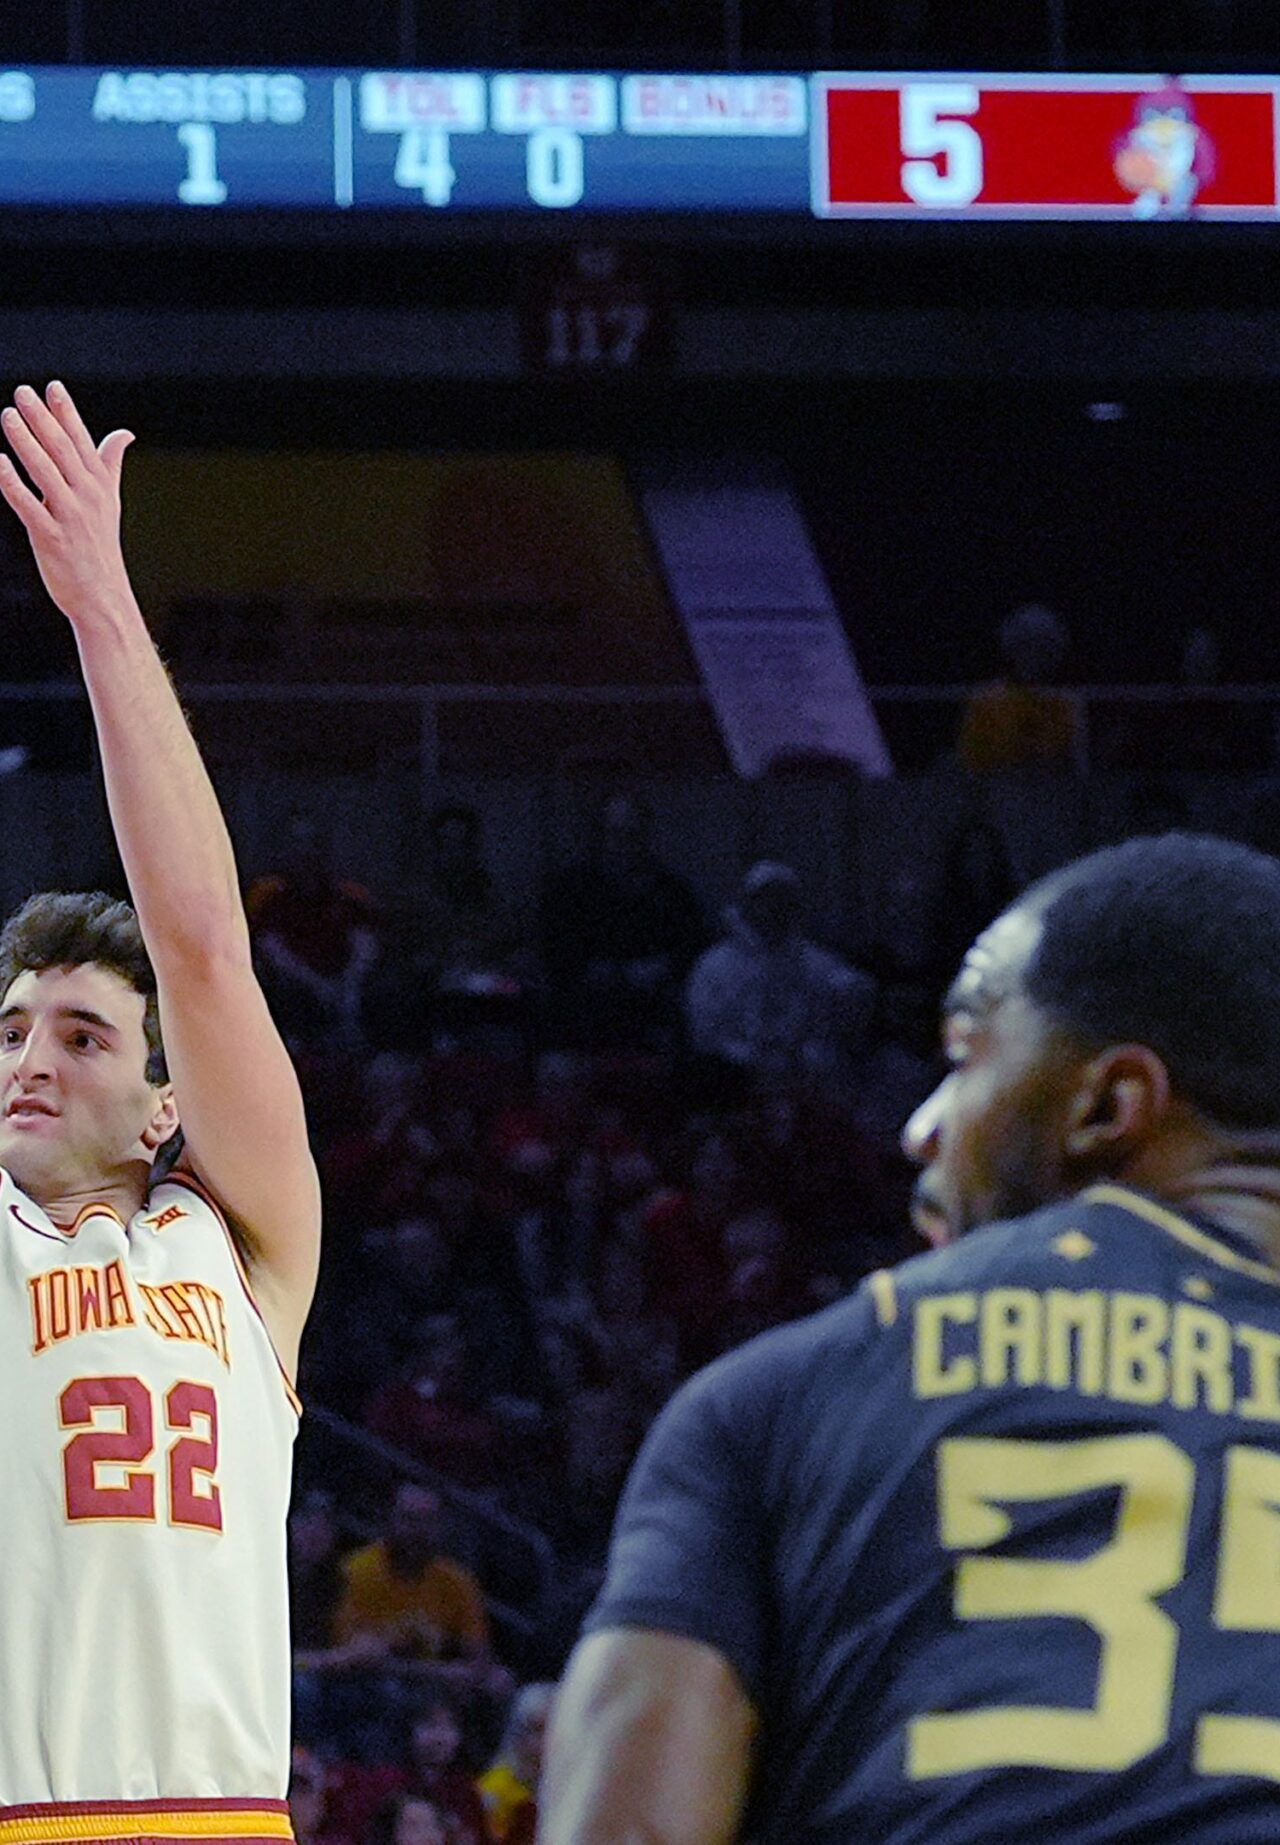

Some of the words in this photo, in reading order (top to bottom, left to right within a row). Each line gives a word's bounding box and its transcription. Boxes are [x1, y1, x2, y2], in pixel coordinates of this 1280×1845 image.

[93, 73, 307, 124] ASSISTS
[177, 122, 228, 204] 1
[394, 130, 457, 207] 4
[526, 127, 584, 208] 0
[898, 83, 984, 209] 5
[544, 305, 648, 363] 117
[27, 1257, 136, 1357] IOWA
[57, 1373, 224, 1535] 22
